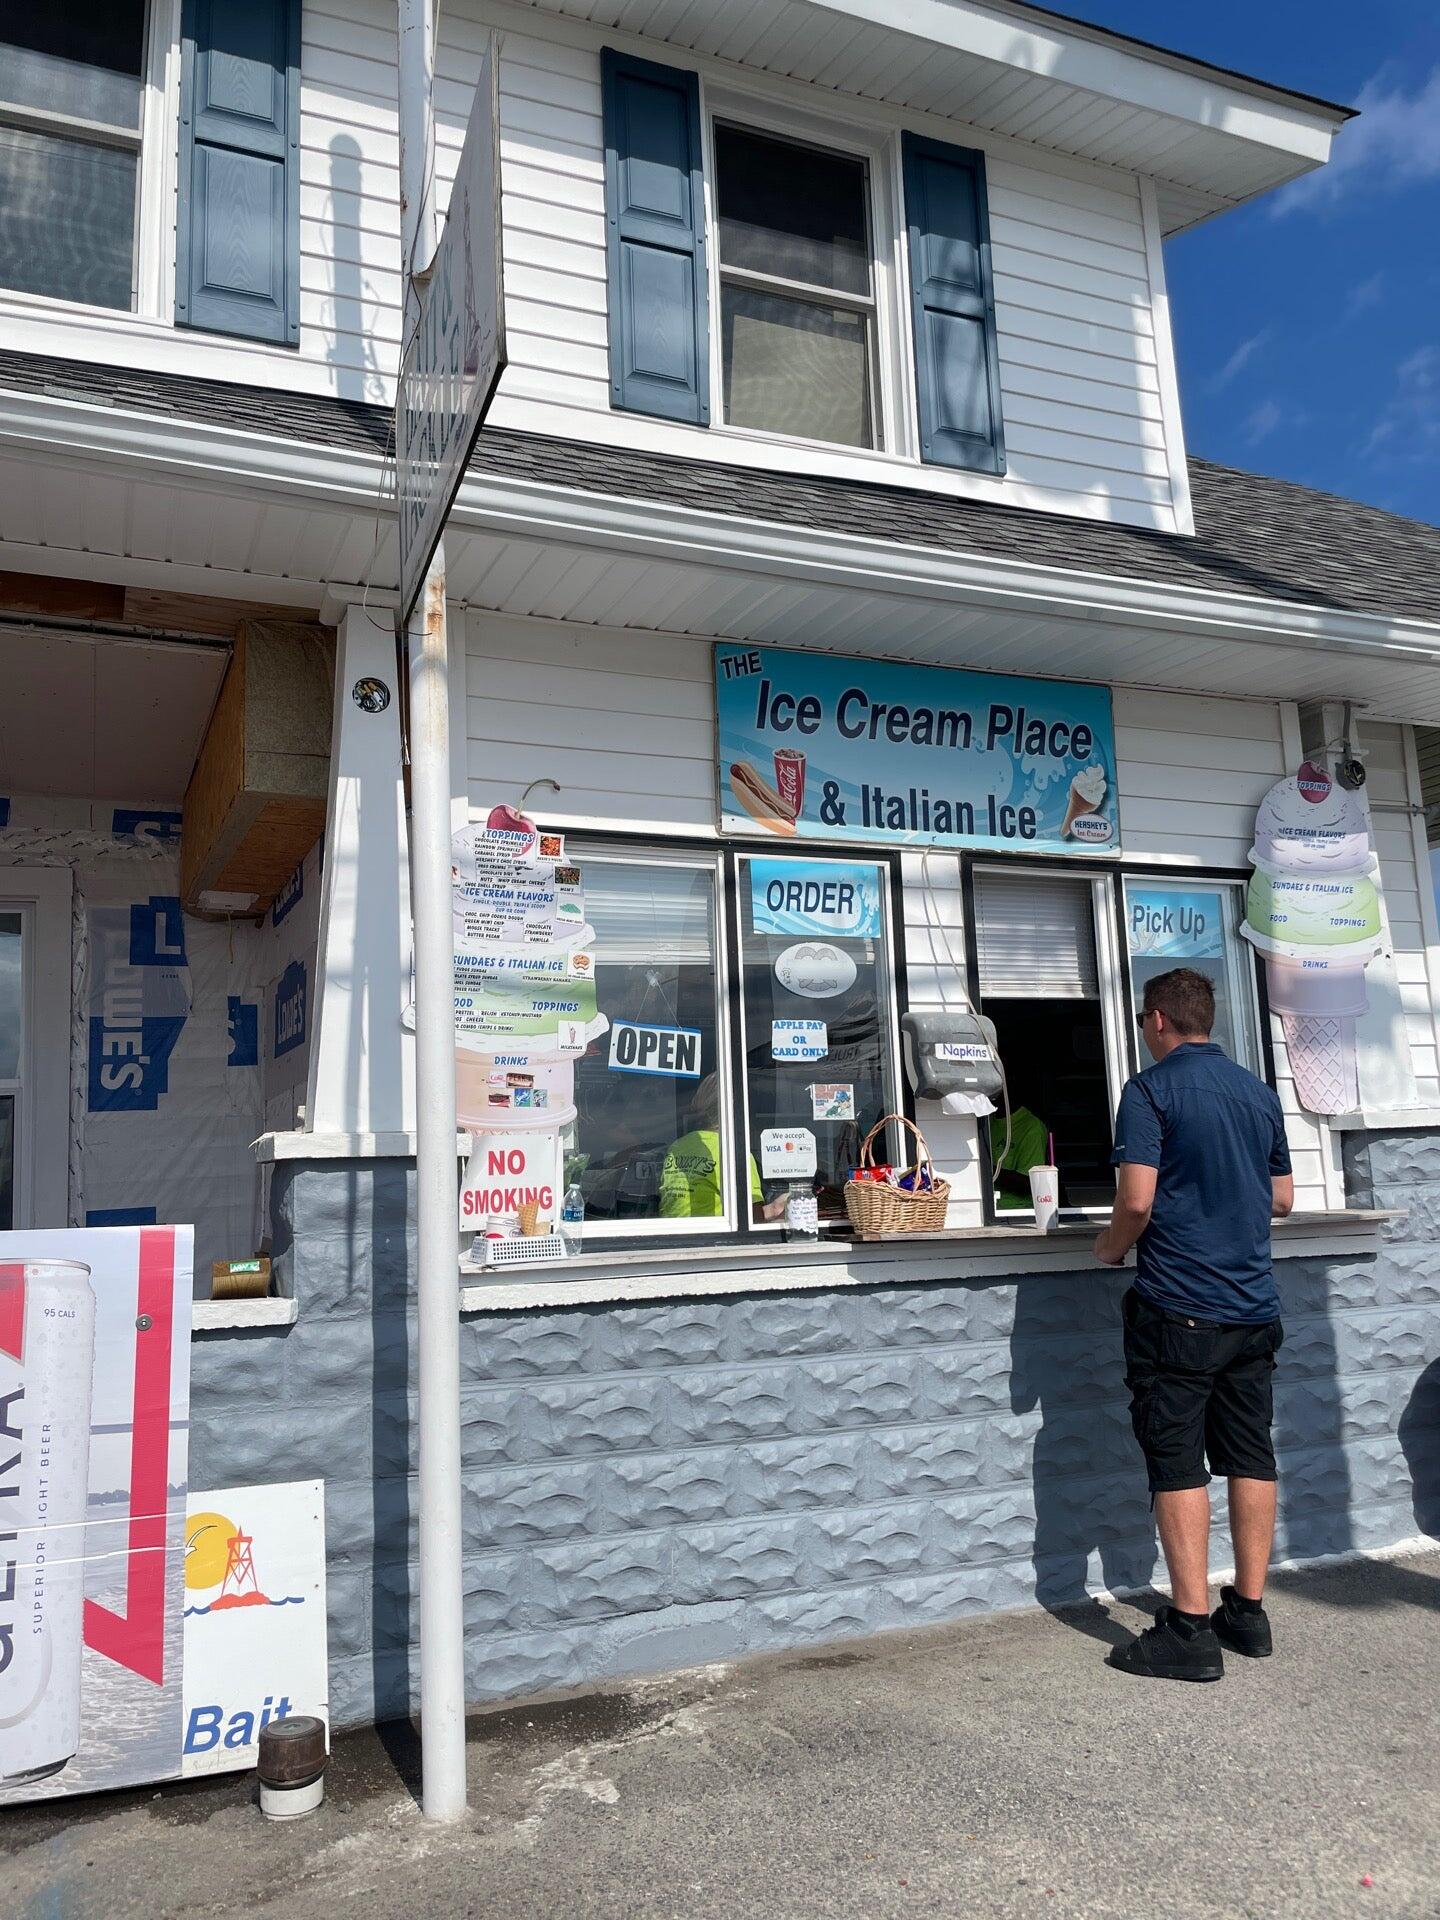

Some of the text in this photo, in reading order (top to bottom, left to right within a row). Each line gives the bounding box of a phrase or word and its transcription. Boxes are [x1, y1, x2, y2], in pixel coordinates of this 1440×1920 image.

[720, 652, 762, 679] THE
[756, 680, 1092, 760] Ice Cream Place
[1297, 781, 1331, 791] TOPPINGS
[820, 781, 1037, 839] & Italian Ice
[1075, 820, 1108, 831] HERSHEY'S
[486, 830, 534, 842] TOPPINGS
[1294, 829, 1317, 837] CREAM
[1318, 831, 1346, 839] FLAVORS
[1272, 881, 1304, 891] SUNDAES
[1312, 884, 1340, 893] ITALIAN
[1341, 886, 1354, 894] ICE
[465, 888, 554, 902] ICE CREAM FLAVORS
[766, 879, 855, 914] ORDER
[1132, 905, 1205, 941] Pick Up
[1269, 914, 1366, 927] FOOD TOPPINGS
[454, 955, 563, 971] SUNDAES & ITALIAN ICE
[455, 998, 579, 1012] OOD TOPPINGS
[774, 1021, 823, 1030] APPLE PAY
[792, 1036, 807, 1044] OR
[616, 1027, 696, 1071] OPEN
[772, 1047, 799, 1056] CARD
[802, 1048, 828, 1056] ONLY
[943, 1044, 987, 1059] Napkins
[494, 1056, 528, 1065] DRINKS
[488, 1150, 525, 1176] NO
[463, 1186, 553, 1215] SMOKING
[44, 1308, 76, 1318] 95 CALS
[33, 1424, 51, 1634] SUPERIOR IGHT BEER
